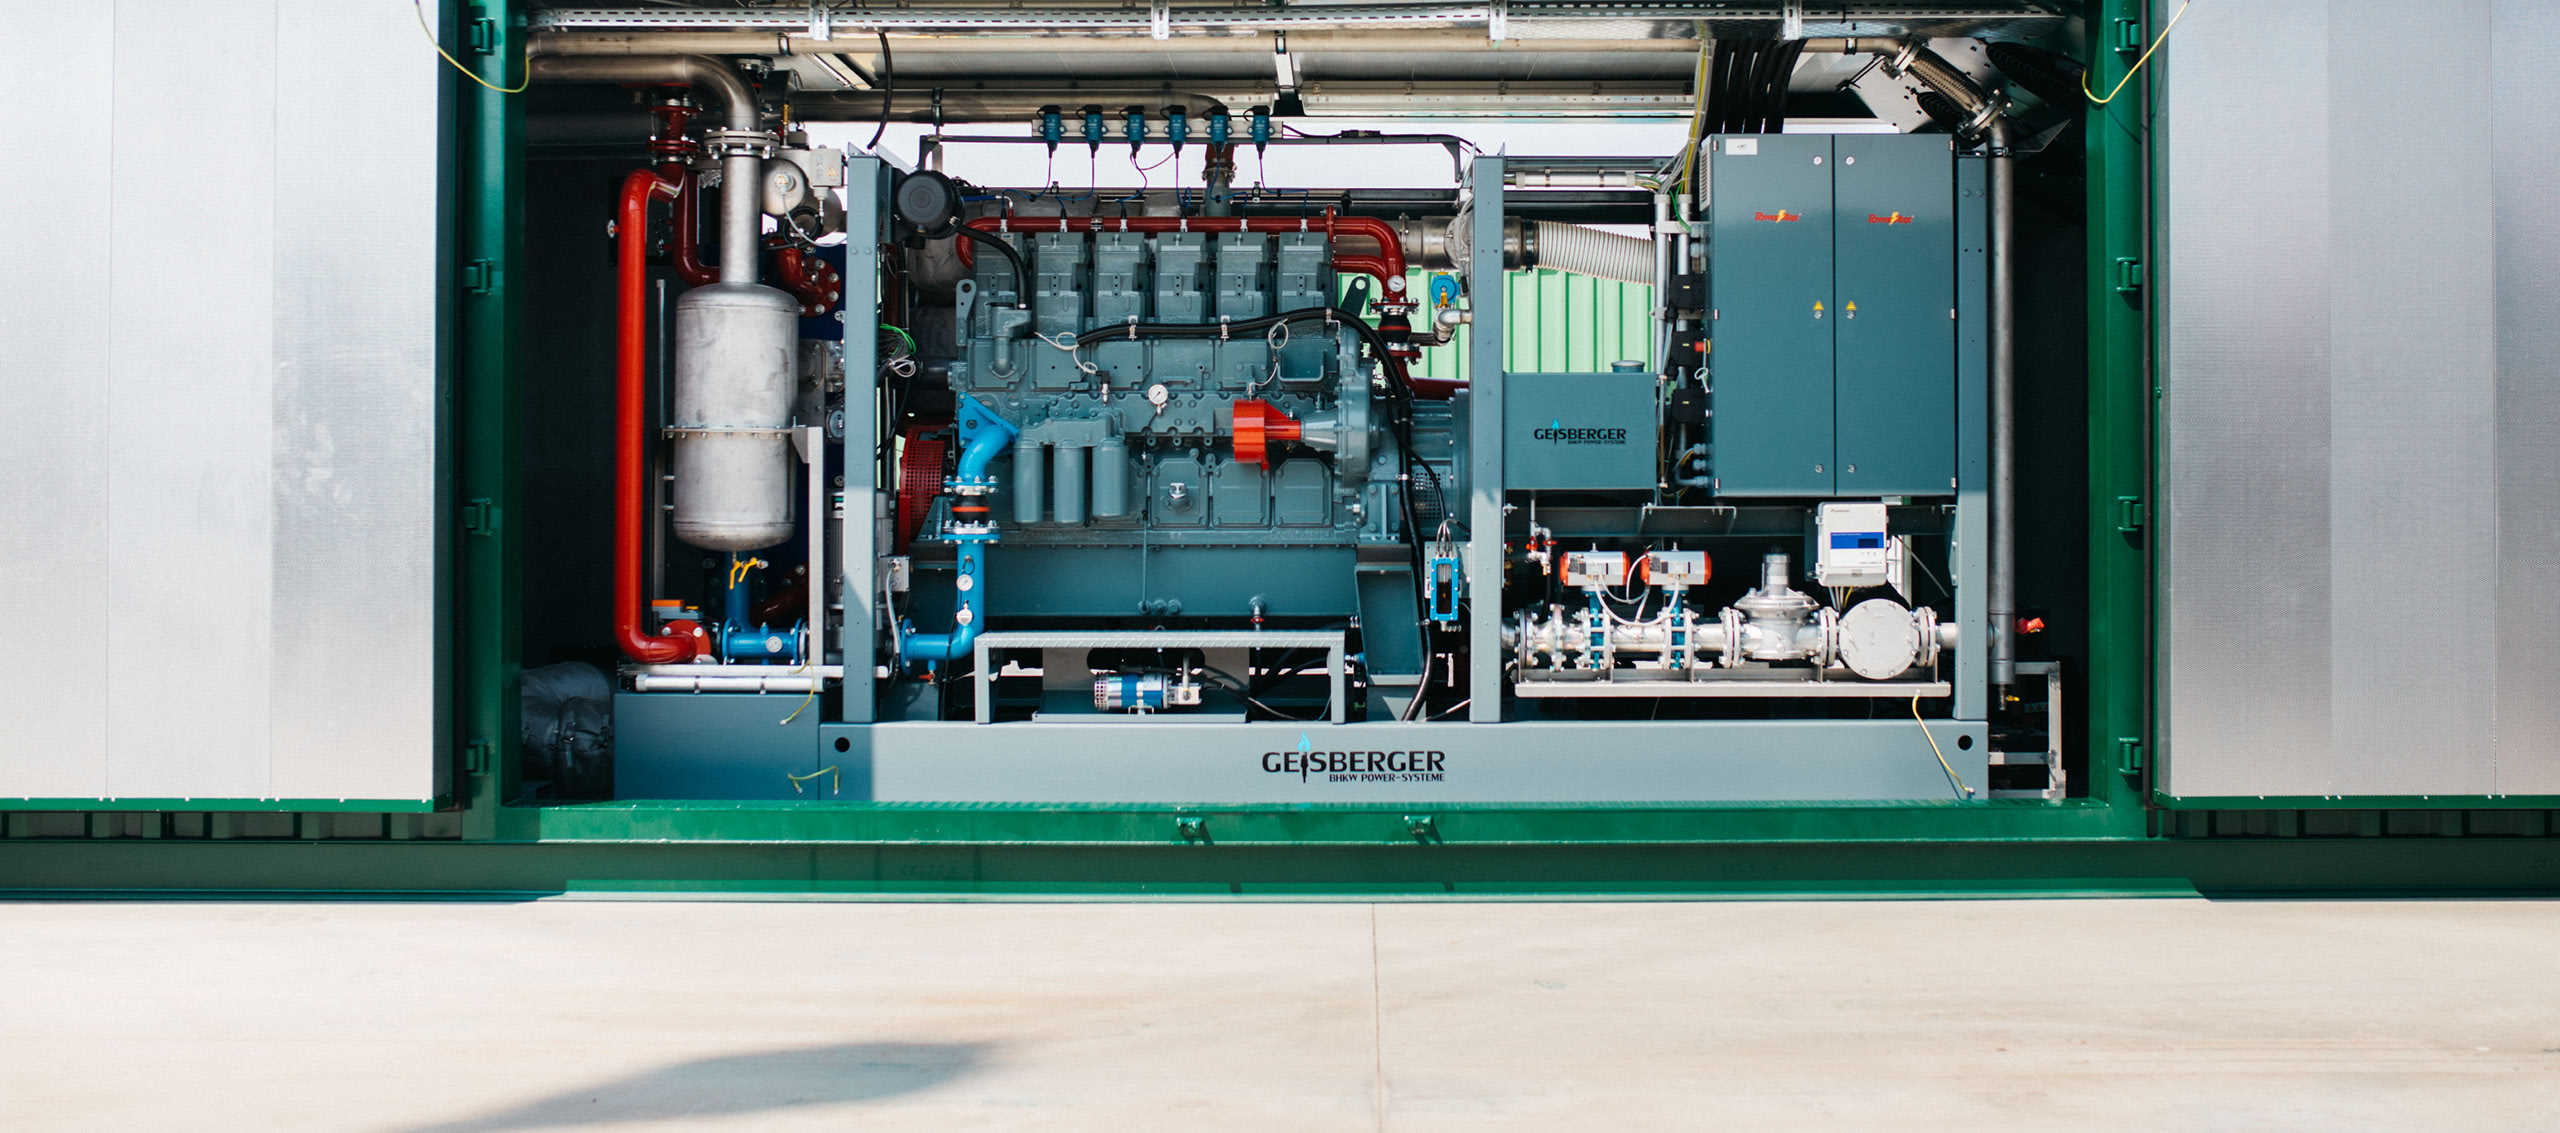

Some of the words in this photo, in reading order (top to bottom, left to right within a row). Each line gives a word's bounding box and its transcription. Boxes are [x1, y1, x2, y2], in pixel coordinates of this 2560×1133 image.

[1534, 428, 1626, 444] GEISBERGER
[1262, 750, 1446, 783] GEISBERGER
[1329, 773, 1358, 783] BHKW
[1361, 773, 1446, 783] POWER-SYSTEME
